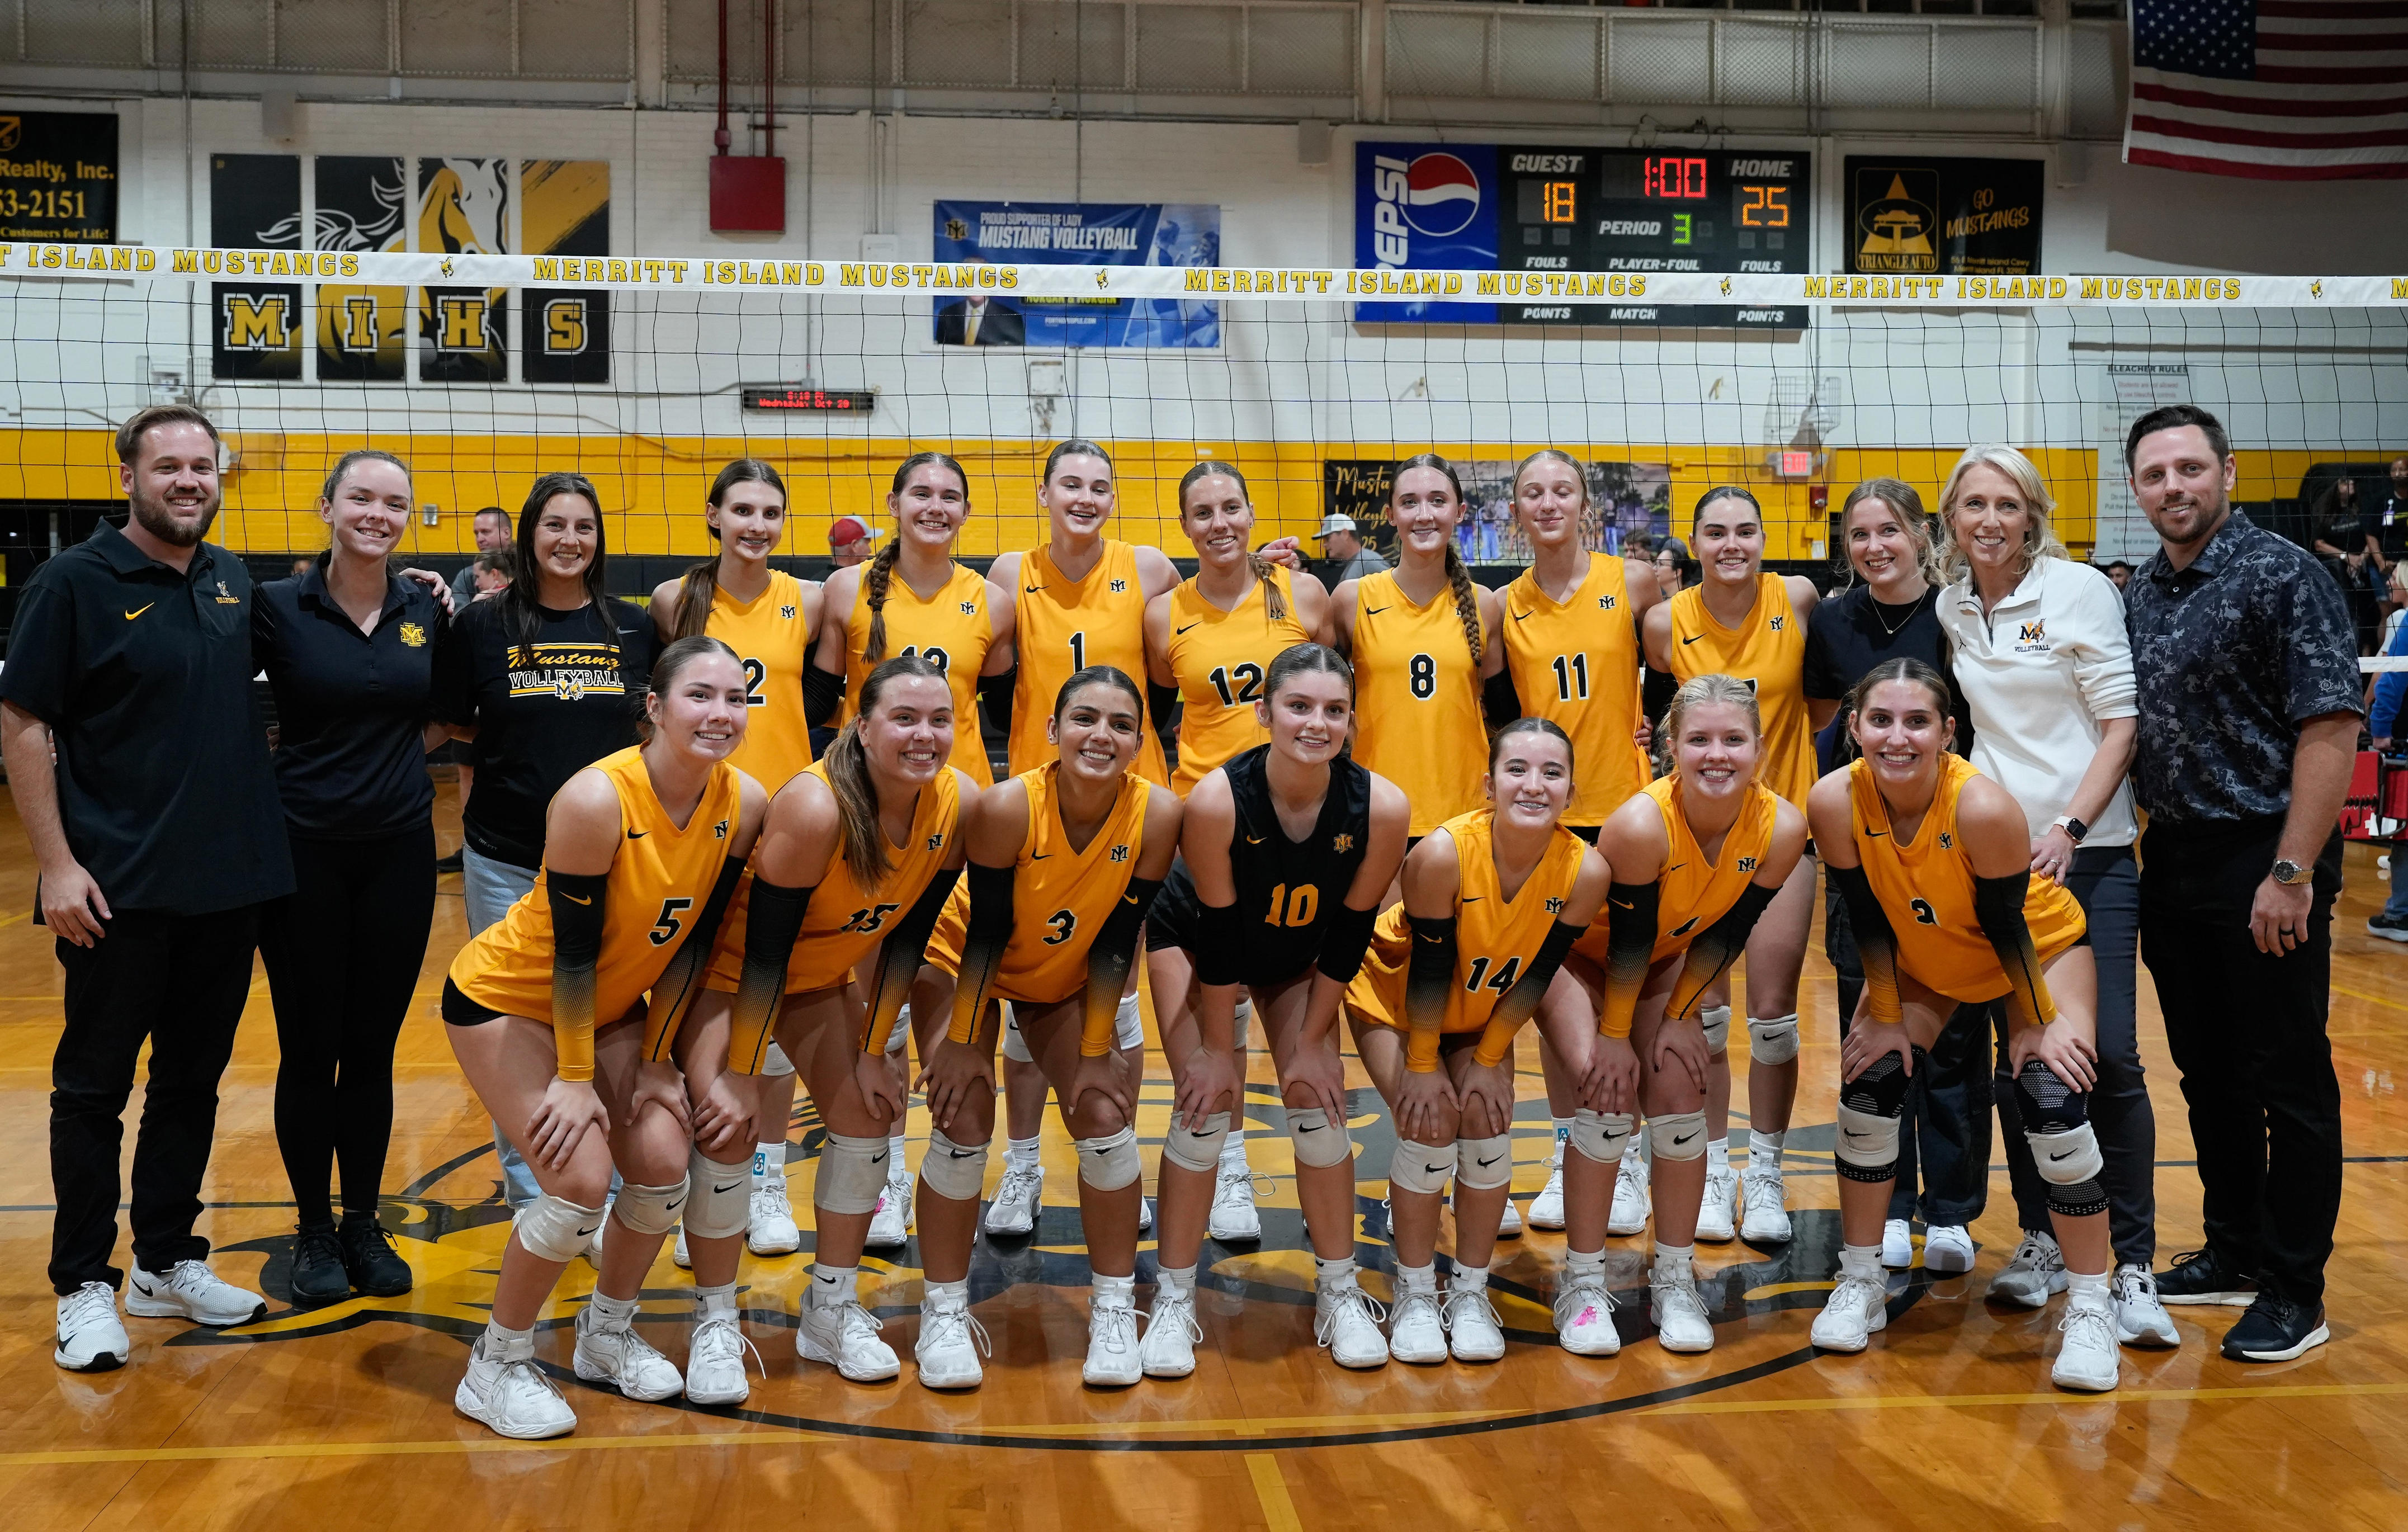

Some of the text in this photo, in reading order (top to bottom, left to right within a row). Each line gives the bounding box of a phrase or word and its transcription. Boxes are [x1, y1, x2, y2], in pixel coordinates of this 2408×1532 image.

[0, 158, 115, 183] Realty, Inc.
[1512, 154, 1583, 173] GUEST
[1730, 159, 1793, 178] HOME
[1644, 157, 1707, 197] 1:00
[1543, 182, 1575, 222] 18
[1742, 186, 1790, 226] 25
[1972, 188, 1994, 210] GO
[980, 212, 1083, 228] PROUD SUPPORTER OF LADY
[1375, 155, 1409, 269] EPSI
[1946, 206, 2029, 239] MUSTANGS
[1, 226, 109, 239] Customers for Life!
[979, 225, 1138, 250] MUSTANG VOLLEYBALL
[1598, 220, 1661, 236] PERIOD
[1673, 213, 1691, 244] 3
[28, 245, 156, 272] ISLAND
[172, 250, 359, 277] MUSTANGS
[533, 257, 1018, 289] MERRITT ISLAND MUSTANGS
[1526, 256, 1567, 268] FOULS
[1609, 258, 1700, 271] PLAYER-FOUL
[1740, 260, 1782, 273] FOULS
[1859, 254, 1935, 269] TRIANGLE AUTO
[1184, 269, 1646, 296] MERRITT ISLAND MUSTANGS
[1803, 276, 2241, 300] MERRITT ISLAND MUSTANGS
[1522, 307, 1571, 319] POINTS
[1610, 308, 1658, 320] MATCH
[1737, 310, 1784, 322] POINTS
[2108, 365, 2155, 373] BLEACHER
[1783, 452, 1808, 473] EXIT
[1335, 465, 1392, 497] Musta
[2014, 644, 2051, 652] VOLLEYBALL
[508, 669, 625, 689] VOLLEYBALL
[1209, 661, 1265, 708] 12
[1409, 652, 1437, 701] 8
[1551, 651, 1589, 702] 11
[1264, 882, 1319, 928] 10
[648, 897, 693, 947] 5
[838, 902, 901, 935] 15
[1041, 908, 1078, 946] 3
[1465, 956, 1522, 998] 14
